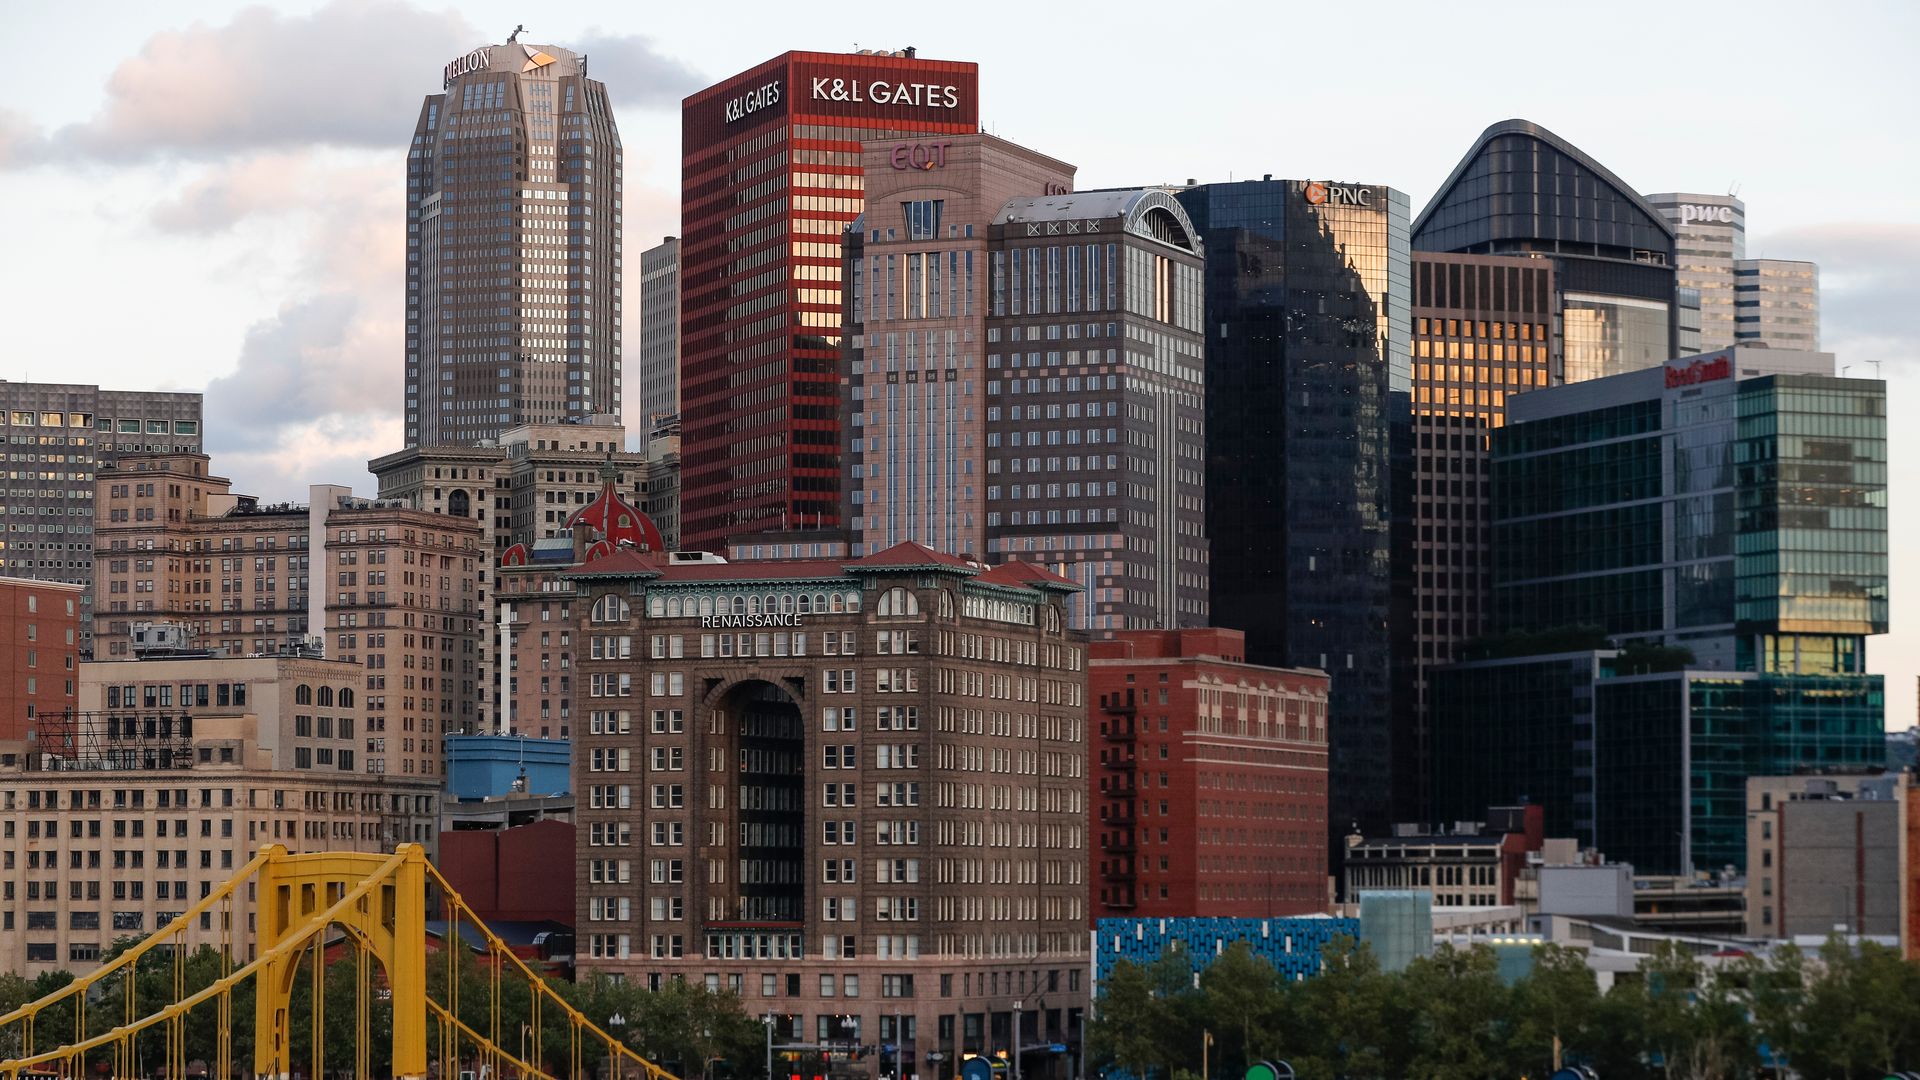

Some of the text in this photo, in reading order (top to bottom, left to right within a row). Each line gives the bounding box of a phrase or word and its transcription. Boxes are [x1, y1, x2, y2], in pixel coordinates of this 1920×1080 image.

[725, 80, 779, 124] K&L GATES
[812, 77, 958, 108] K&L GATES
[890, 140, 951, 171] EQT
[1327, 186, 1371, 206] PNC
[1680, 204, 1732, 227] pwc
[702, 613, 803, 628] RENAISSANCE
